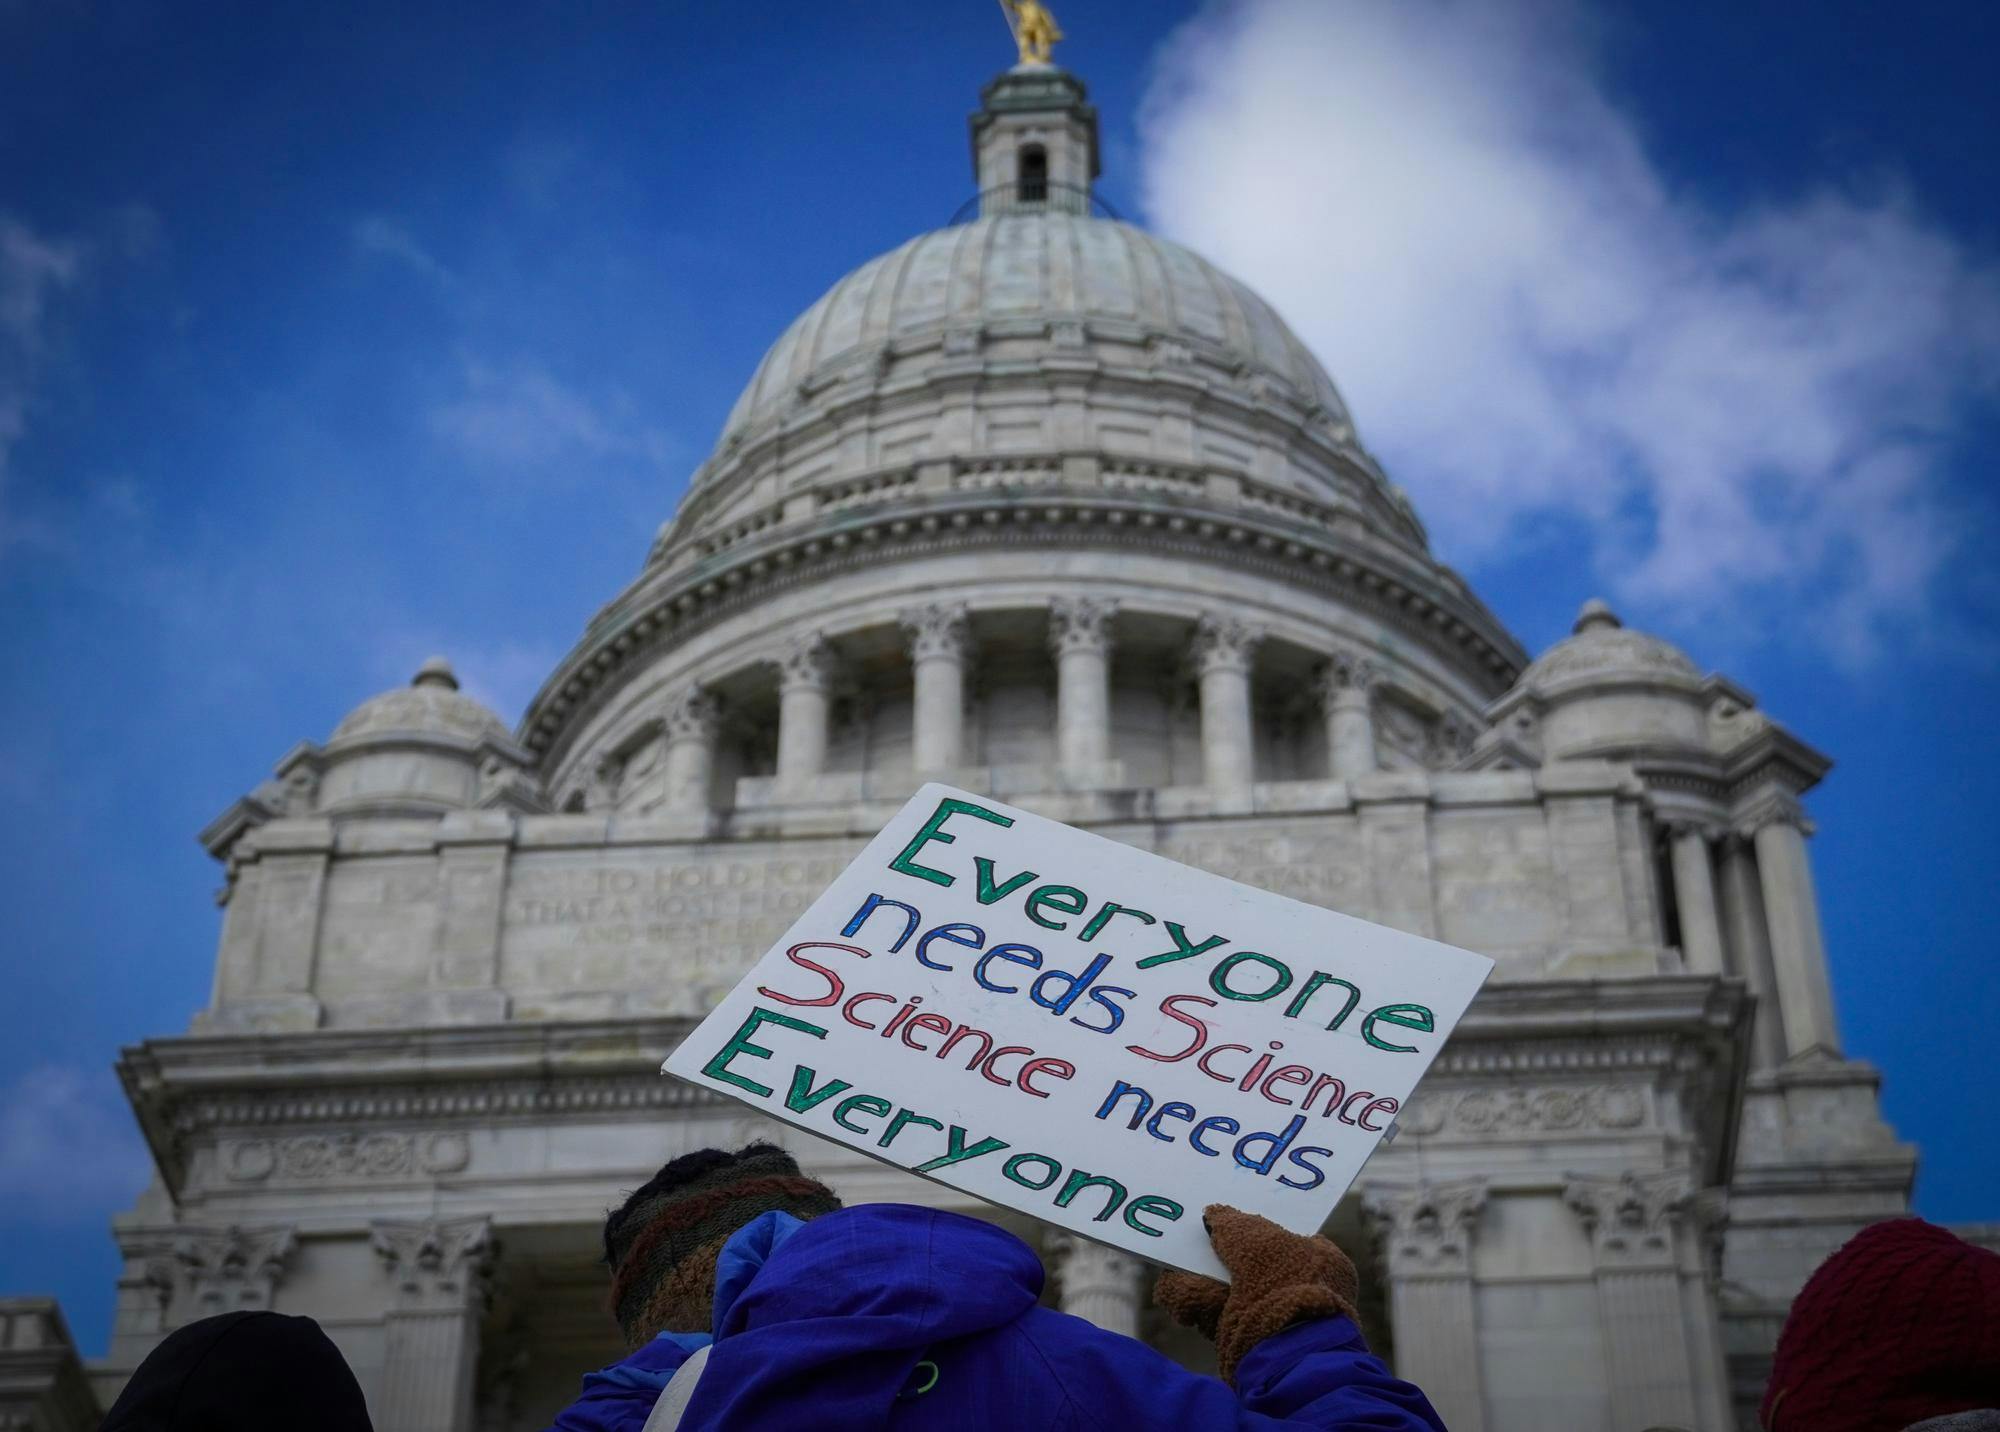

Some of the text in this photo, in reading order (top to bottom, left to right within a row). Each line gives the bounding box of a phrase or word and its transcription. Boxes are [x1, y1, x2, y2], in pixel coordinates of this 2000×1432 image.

[653, 864, 753, 893] HOLD
[888, 798, 1434, 1053] Everyone
[700, 1006, 1184, 1237] Everyone
[757, 942, 1333, 1191] Science needs
[840, 893, 1398, 1131] needs Science
